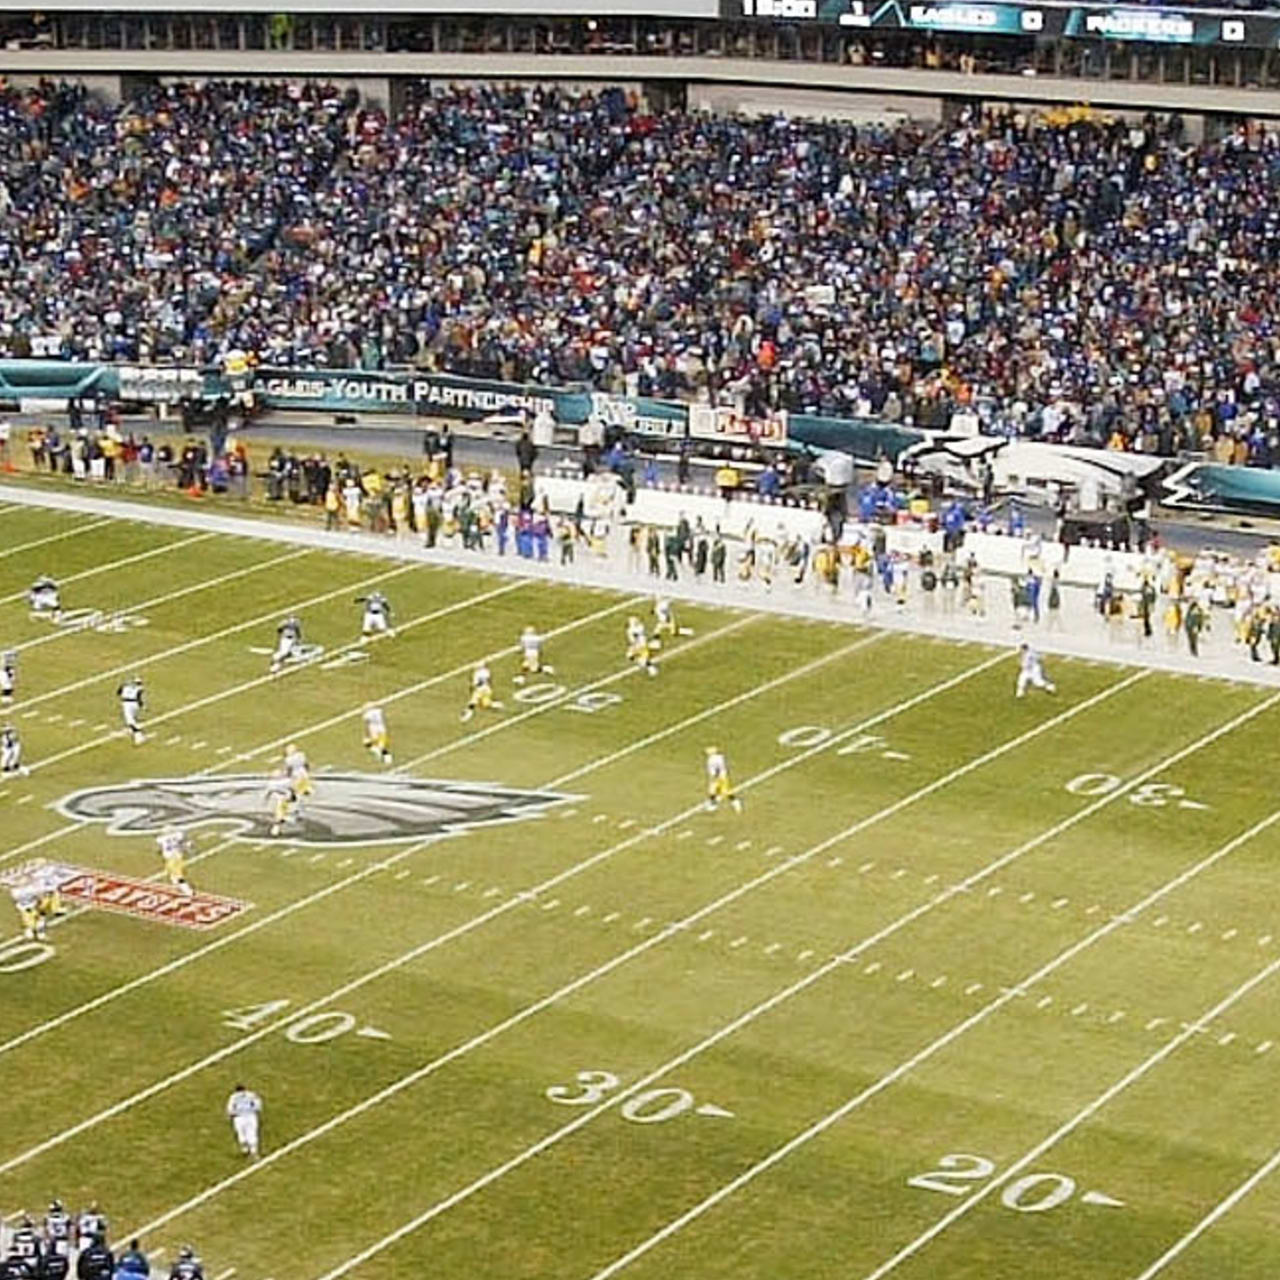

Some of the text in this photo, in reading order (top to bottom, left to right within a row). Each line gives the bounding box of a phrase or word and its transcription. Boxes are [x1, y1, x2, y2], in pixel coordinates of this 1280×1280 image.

[910, 6, 997, 25] EAGLES
[325, 377, 407, 402] YOUTH
[414, 380, 554, 413] PARTNERSHIP
[221, 998, 357, 1043] 40
[546, 1070, 695, 1122] 30
[906, 1153, 1077, 1212] 20
